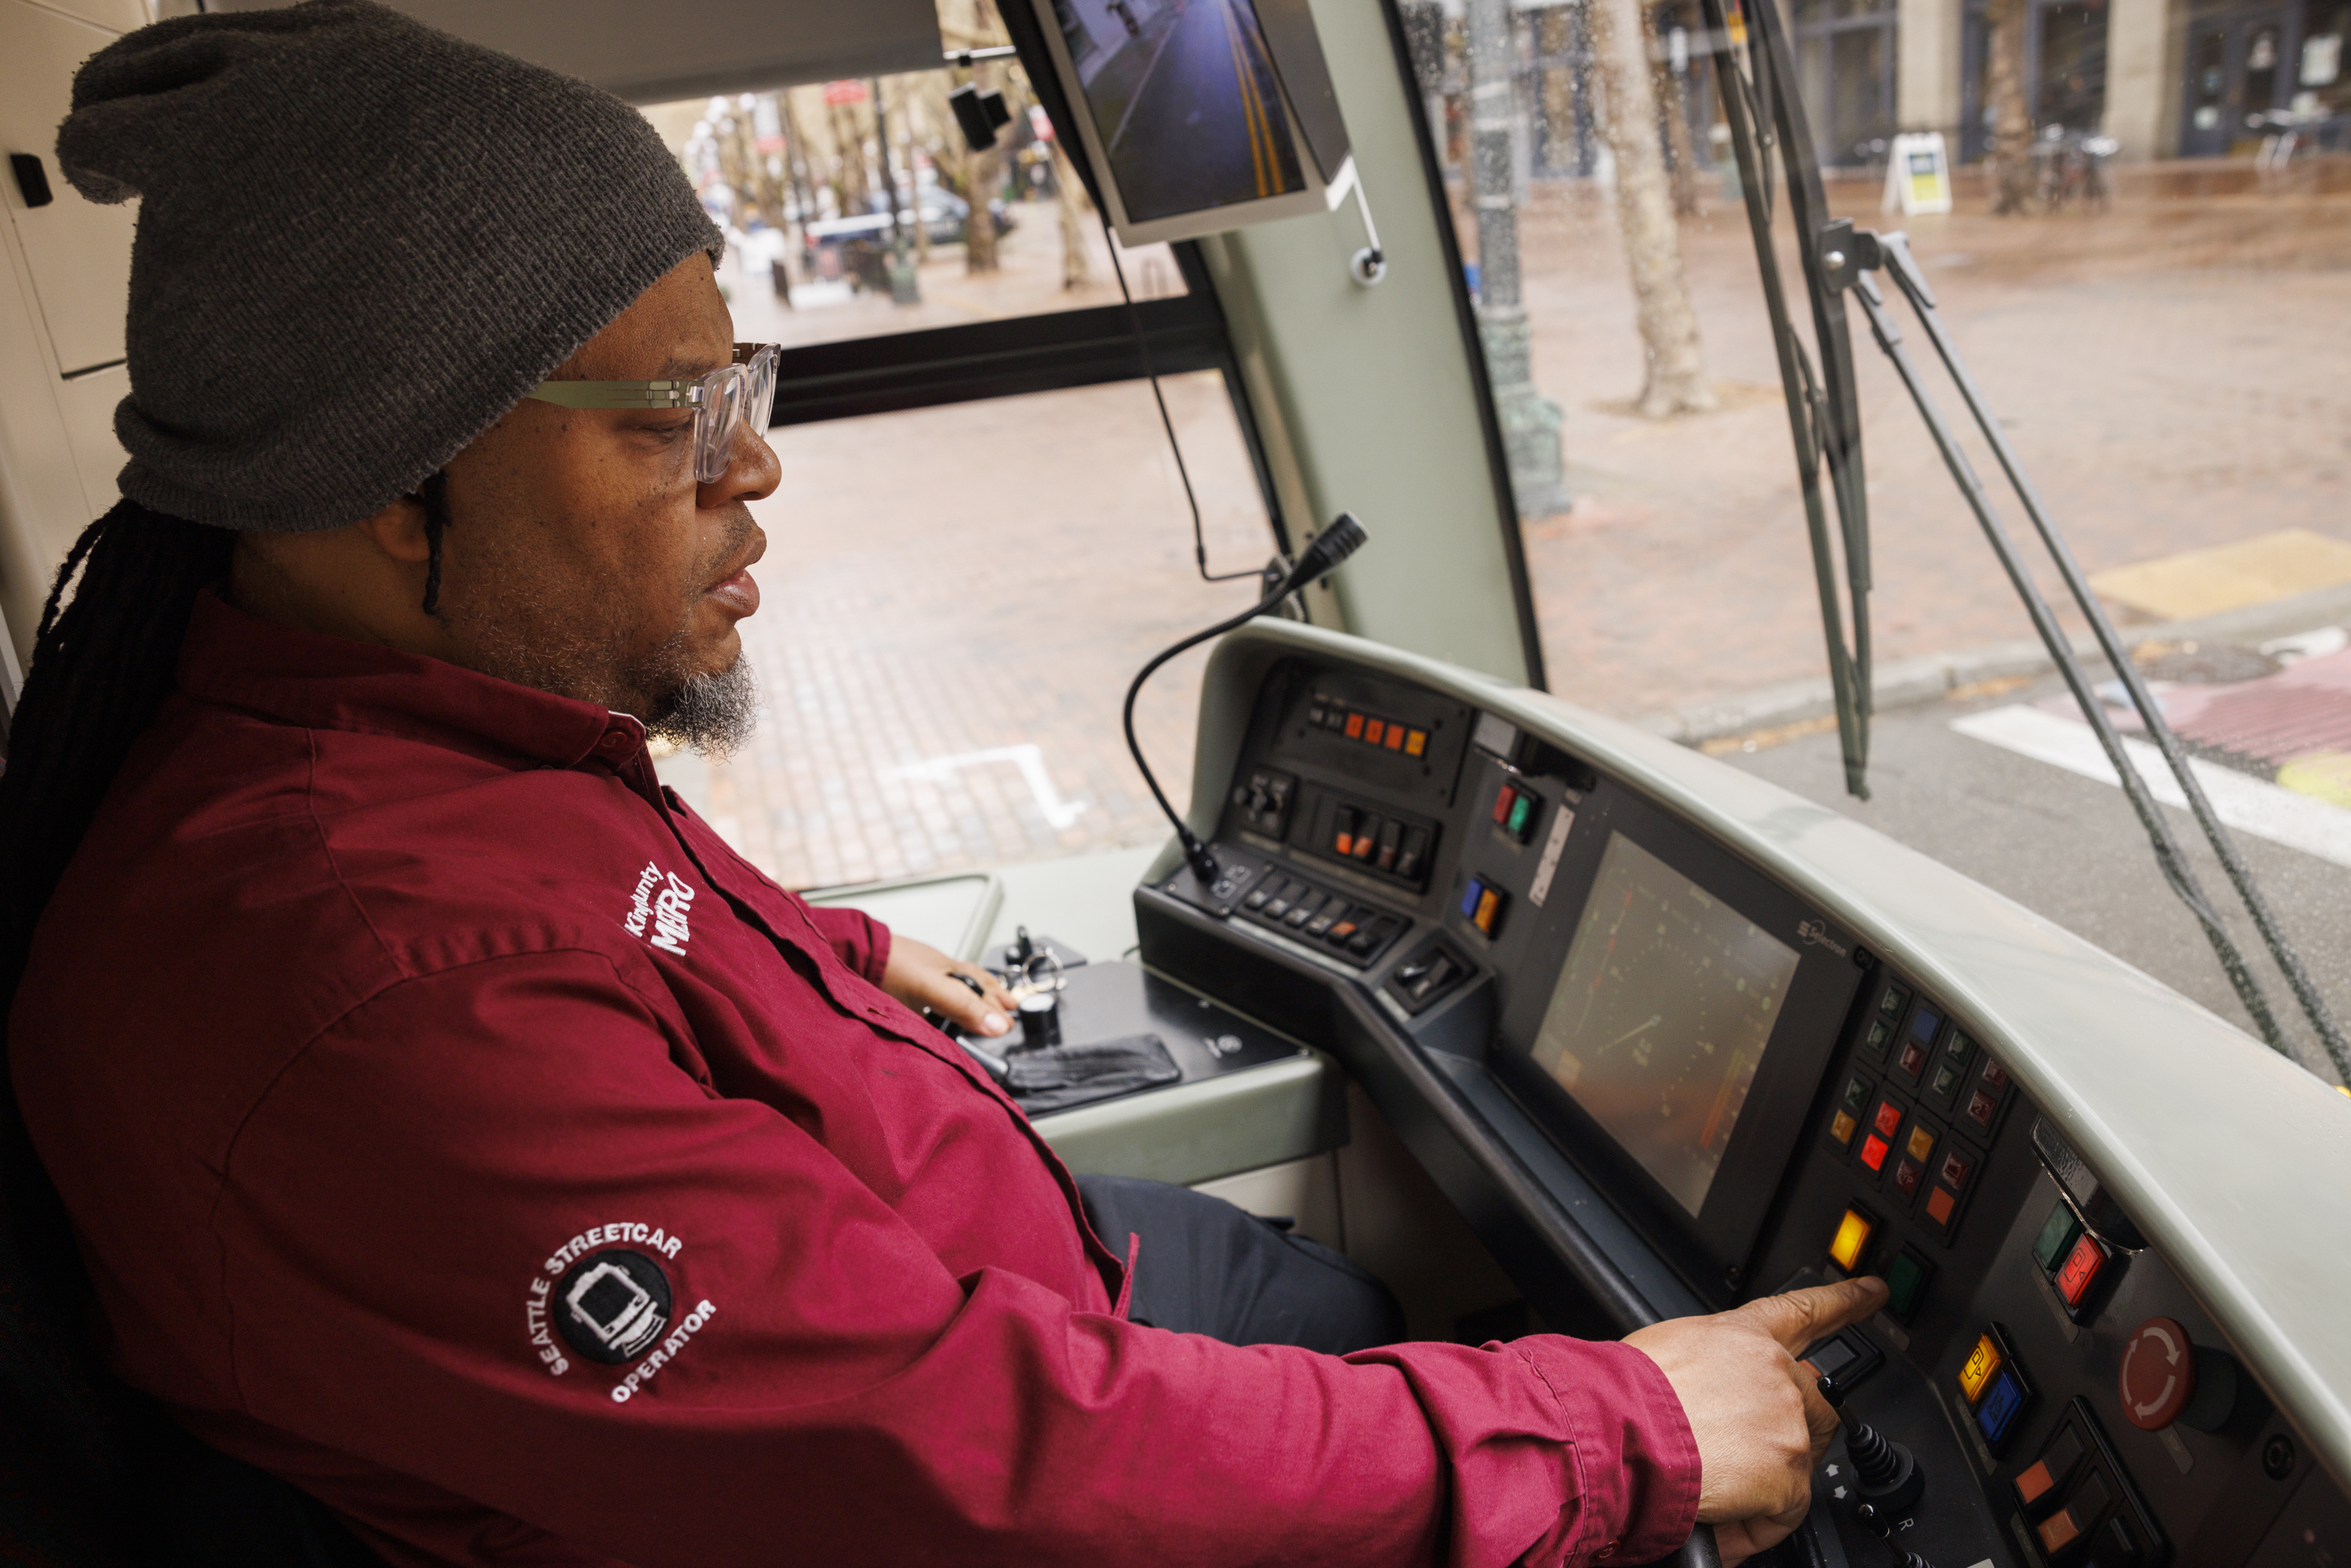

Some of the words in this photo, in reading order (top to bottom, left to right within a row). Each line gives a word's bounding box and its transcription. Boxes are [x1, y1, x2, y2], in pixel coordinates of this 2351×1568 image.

[545, 1222, 682, 1275] STREETCAR
[526, 1277, 569, 1375] SEATTLE
[611, 1299, 716, 1403] OPERATOR
[1899, 1517, 1914, 1531] R
